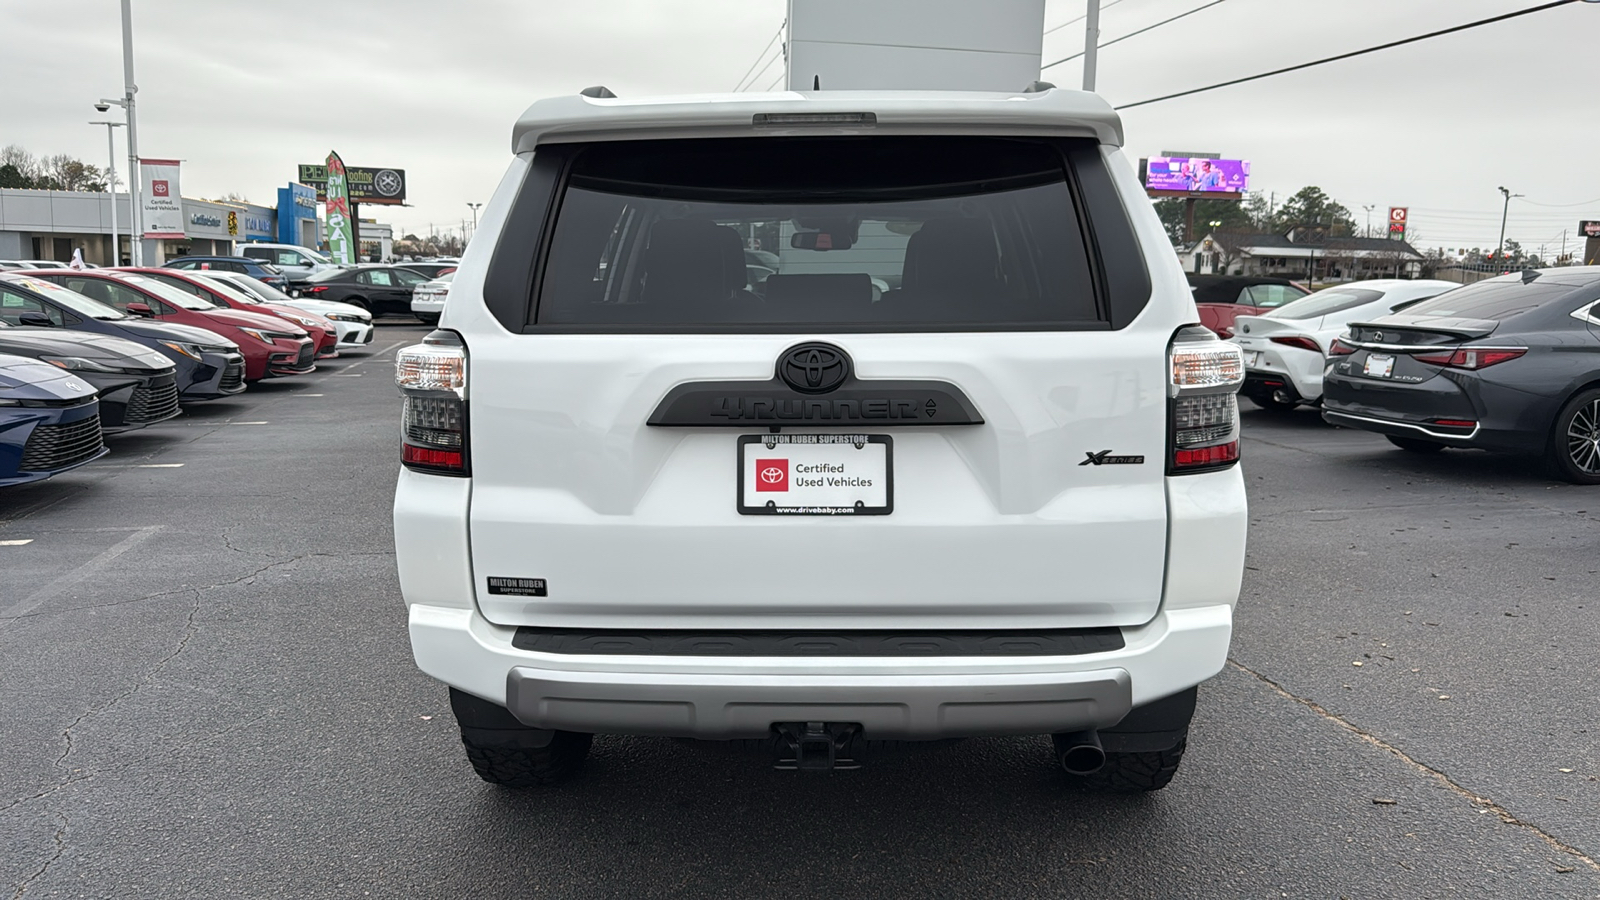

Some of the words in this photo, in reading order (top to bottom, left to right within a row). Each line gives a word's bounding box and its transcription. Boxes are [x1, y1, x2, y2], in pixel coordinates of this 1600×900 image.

[761, 435, 790, 444] MILTON
[791, 435, 818, 444] RUBEN
[818, 435, 869, 444] SUPERSTORE
[795, 463, 845, 473] Certified
[795, 477, 824, 487] Used
[826, 477, 873, 487] Vehicles
[776, 506, 855, 515] www.drivebaby.com
[490, 578, 518, 587] MILTON
[518, 579, 544, 588] RUBEN
